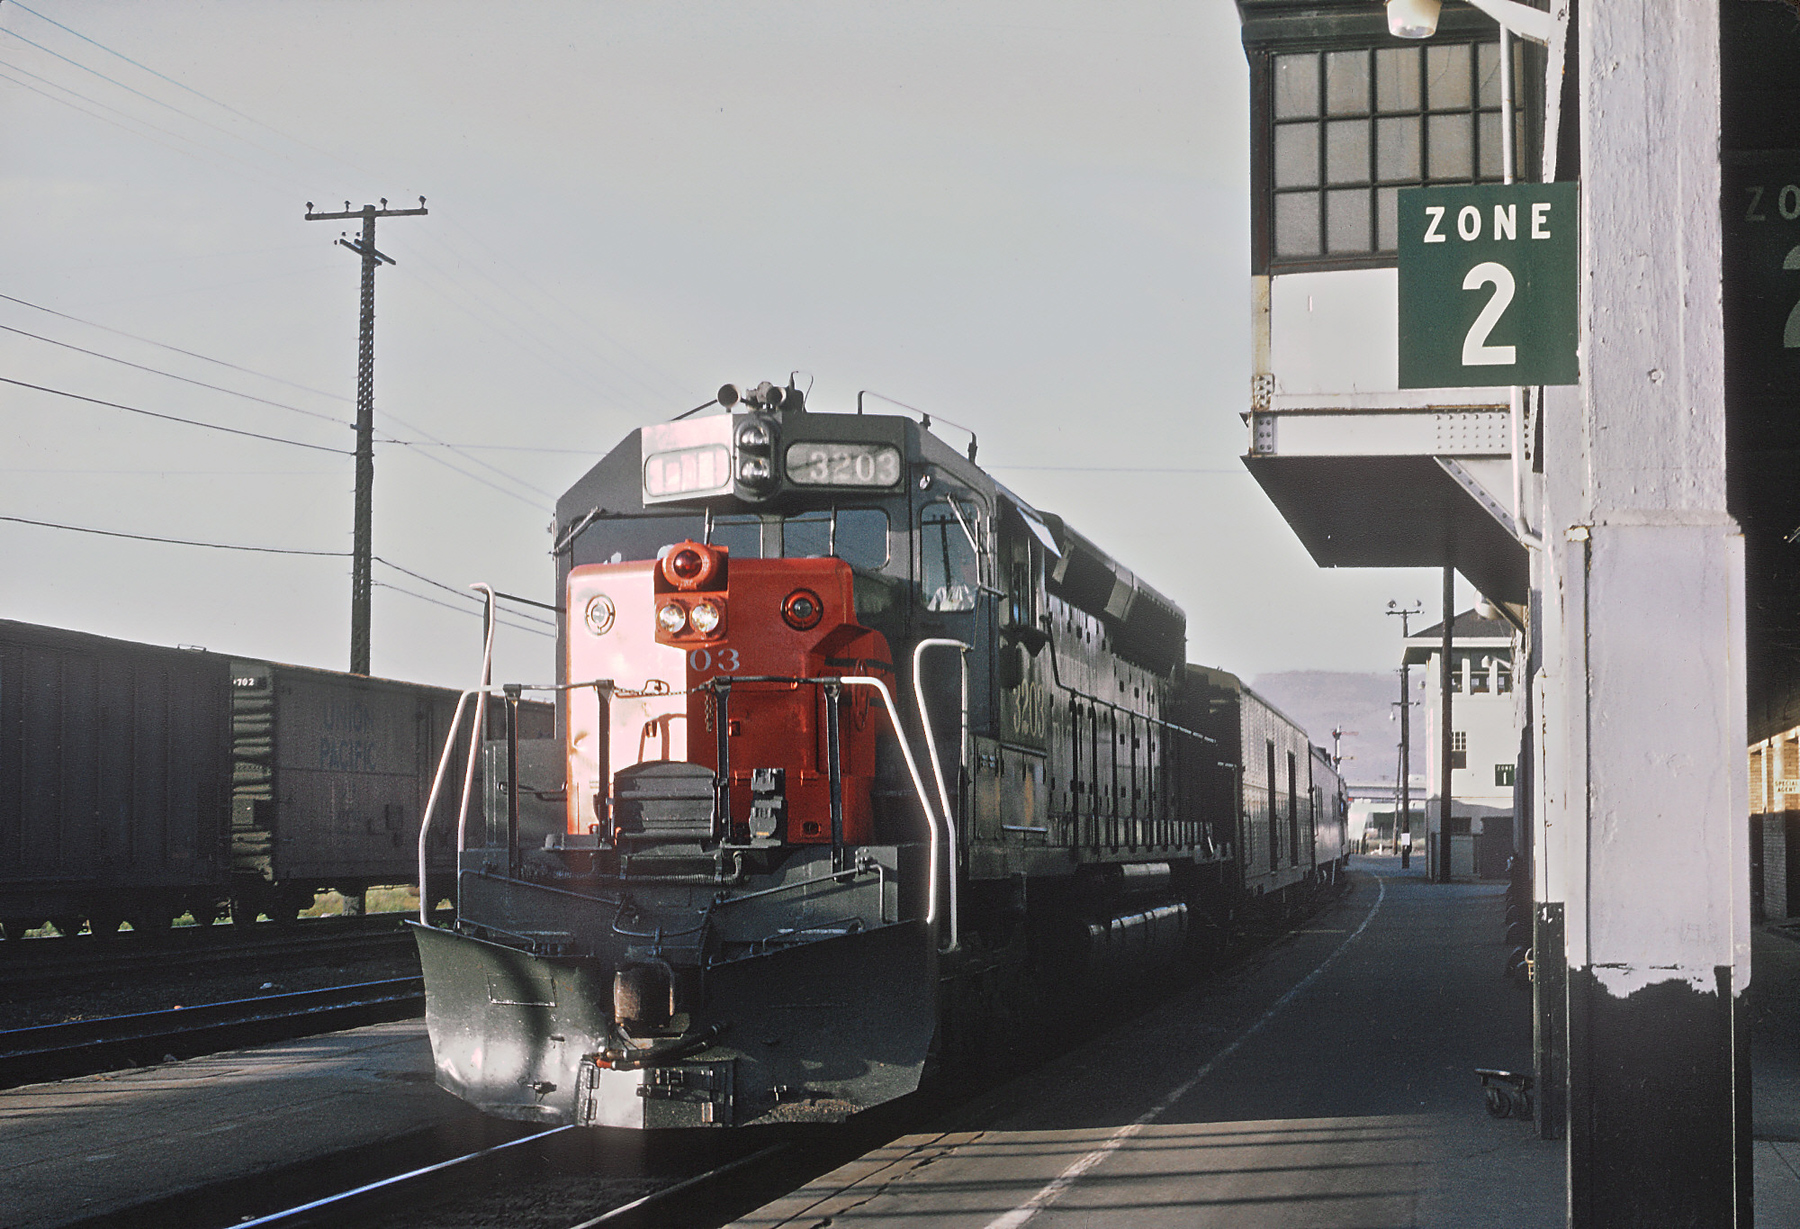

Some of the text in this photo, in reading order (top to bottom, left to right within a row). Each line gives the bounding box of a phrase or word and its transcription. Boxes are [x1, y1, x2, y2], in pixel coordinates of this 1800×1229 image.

[1424, 203, 1551, 243] ZONE
[1462, 262, 1516, 366] 2
[810, 452, 896, 481] 3203
[690, 648, 740, 672] 03
[323, 701, 373, 733] UNION
[1013, 679, 1045, 738] 3203
[319, 737, 377, 773] PACIFIC
